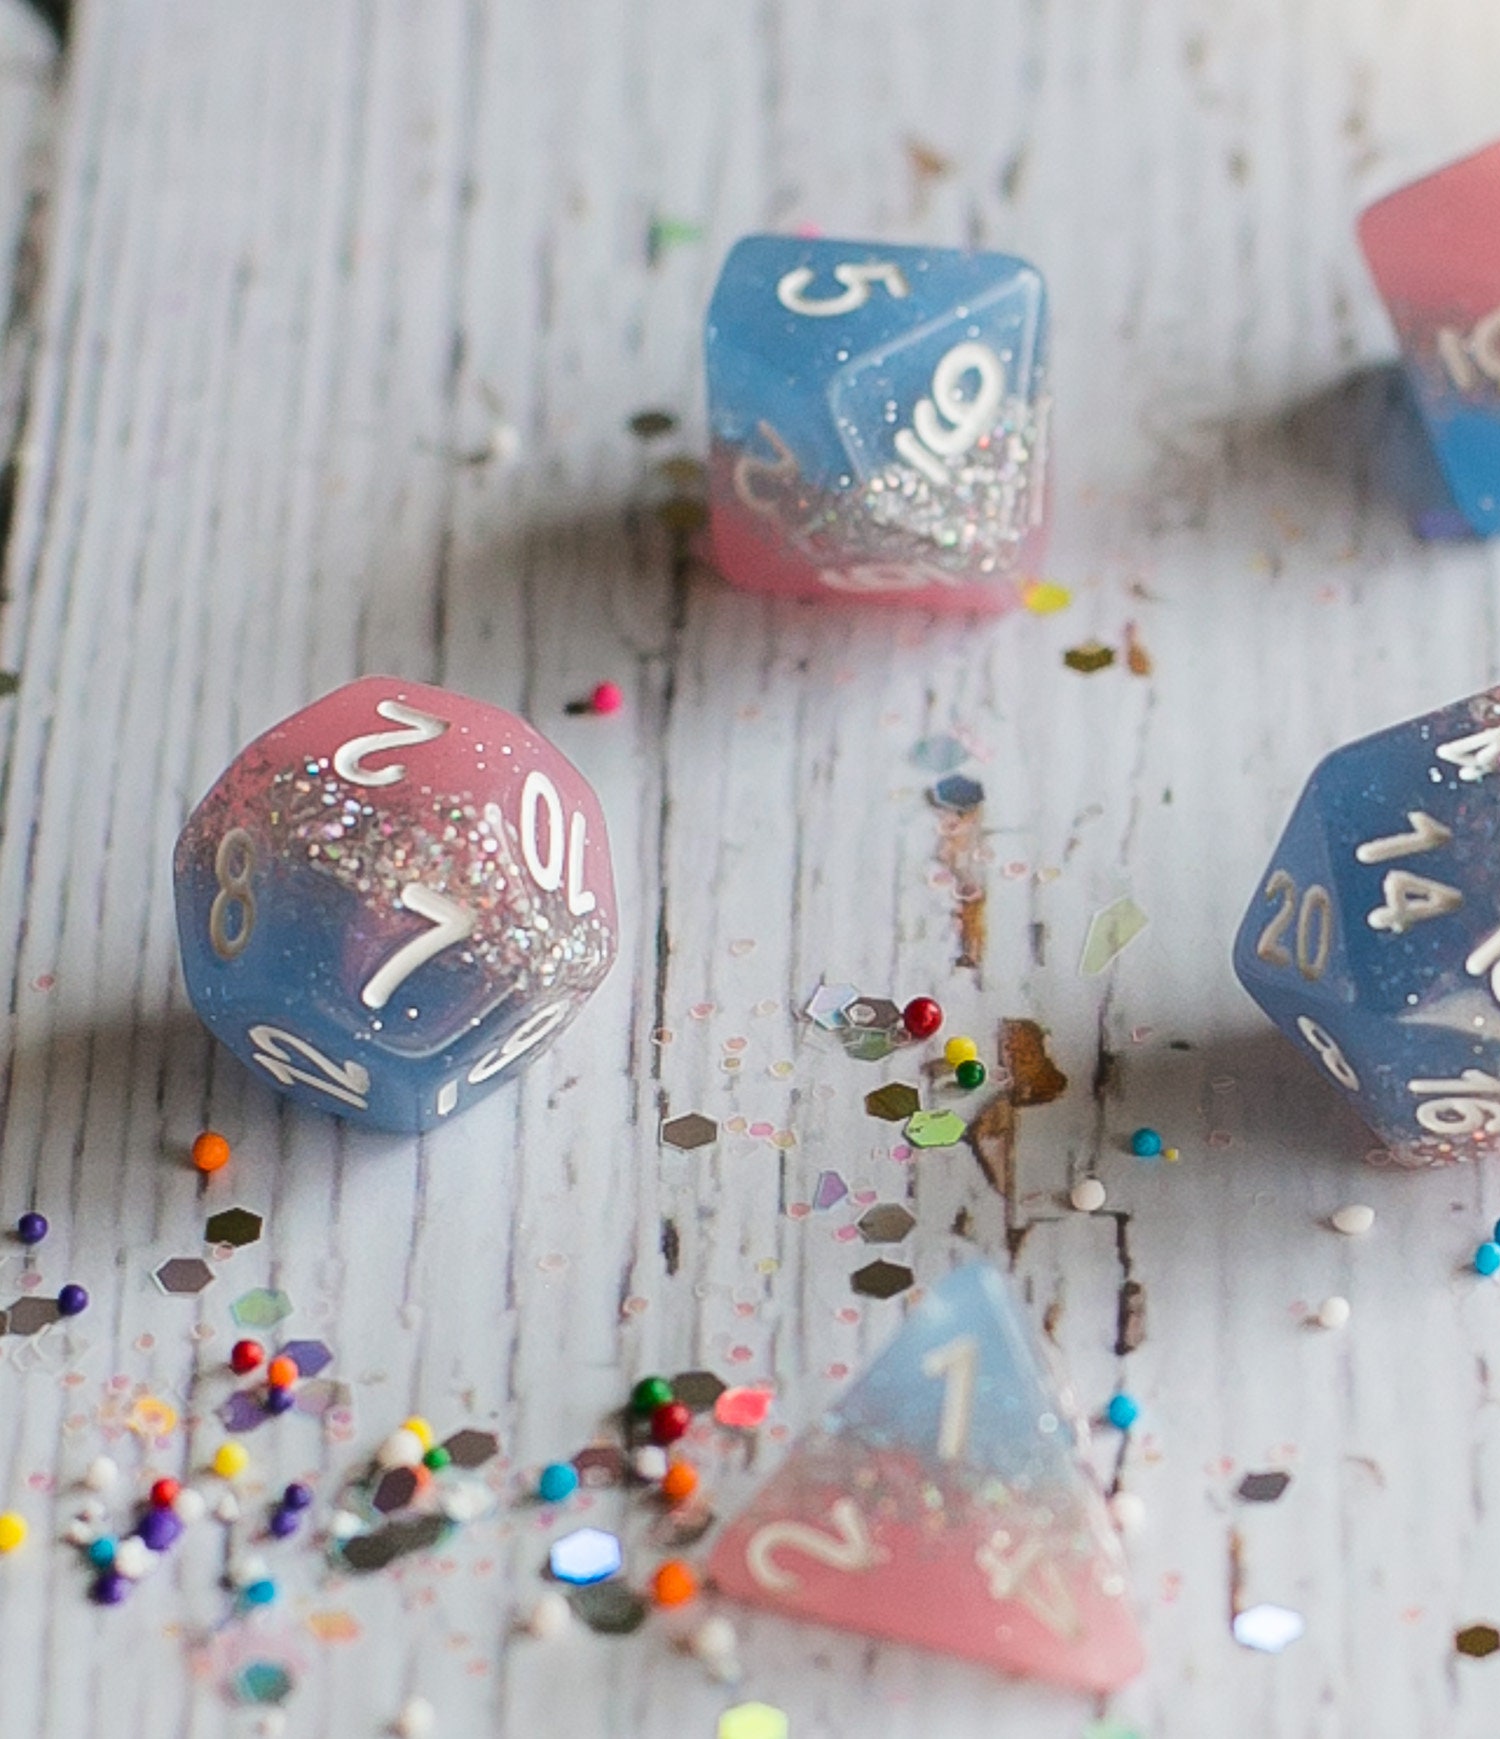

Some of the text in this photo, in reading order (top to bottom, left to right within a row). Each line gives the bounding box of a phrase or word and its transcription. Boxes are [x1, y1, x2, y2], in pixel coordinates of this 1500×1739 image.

[777, 262, 910, 317] 5
[333, 699, 451, 787] 2
[209, 828, 256, 961] 8
[519, 770, 597, 916] 10
[1354, 811, 1464, 934] 14
[361, 882, 478, 1009] 7
[1256, 868, 1331, 982] 20
[248, 1024, 371, 1111] 12
[1297, 1015, 1361, 1092] 8
[922, 1333, 980, 1462] 1
[745, 1497, 885, 1594] 2
